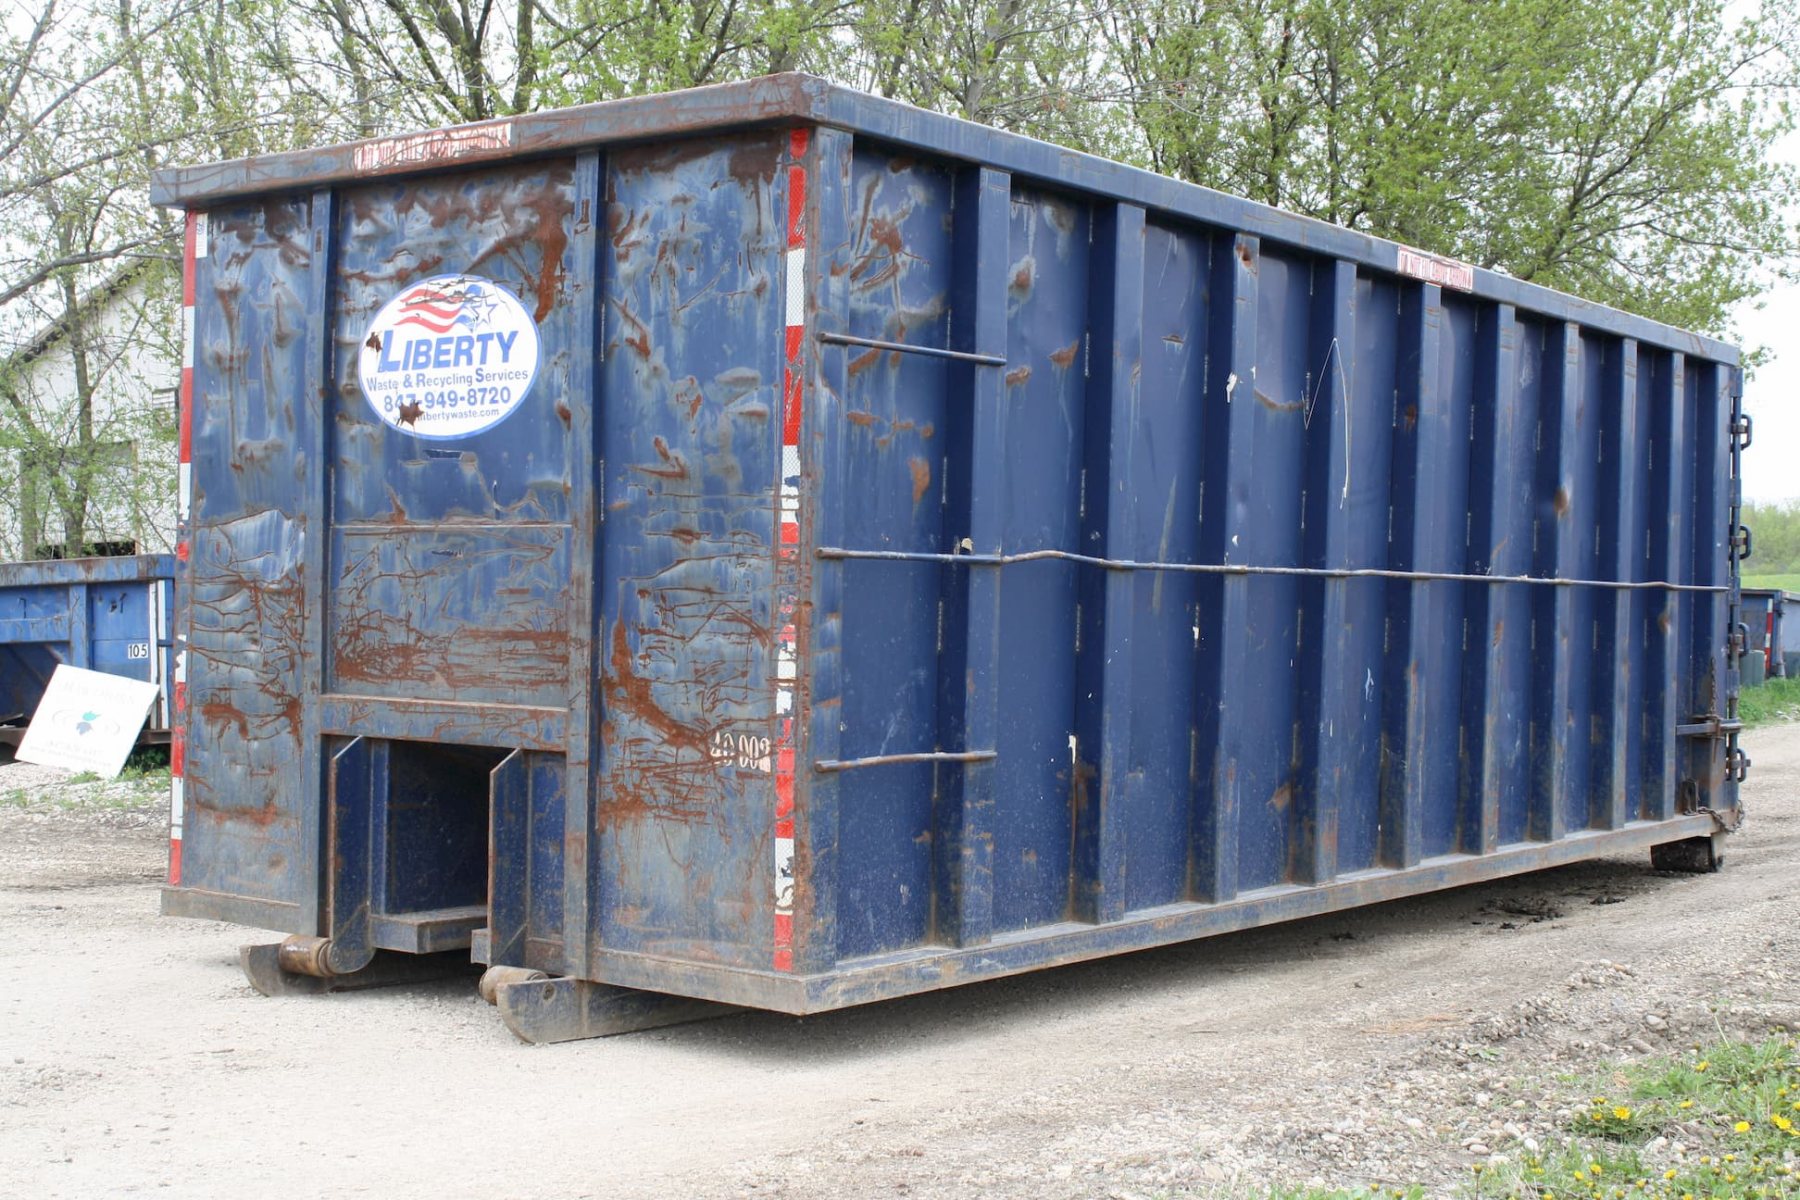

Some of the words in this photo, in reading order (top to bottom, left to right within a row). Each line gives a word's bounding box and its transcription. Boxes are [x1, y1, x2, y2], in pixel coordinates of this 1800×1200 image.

[377, 329, 519, 373] LIBERTY
[366, 377, 399, 392] Waste
[403, 373, 413, 389] &
[416, 371, 473, 388] Recycling
[475, 367, 529, 383] Services
[384, 386, 511, 412] 847-949-8720
[129, 644, 148, 657] 105
